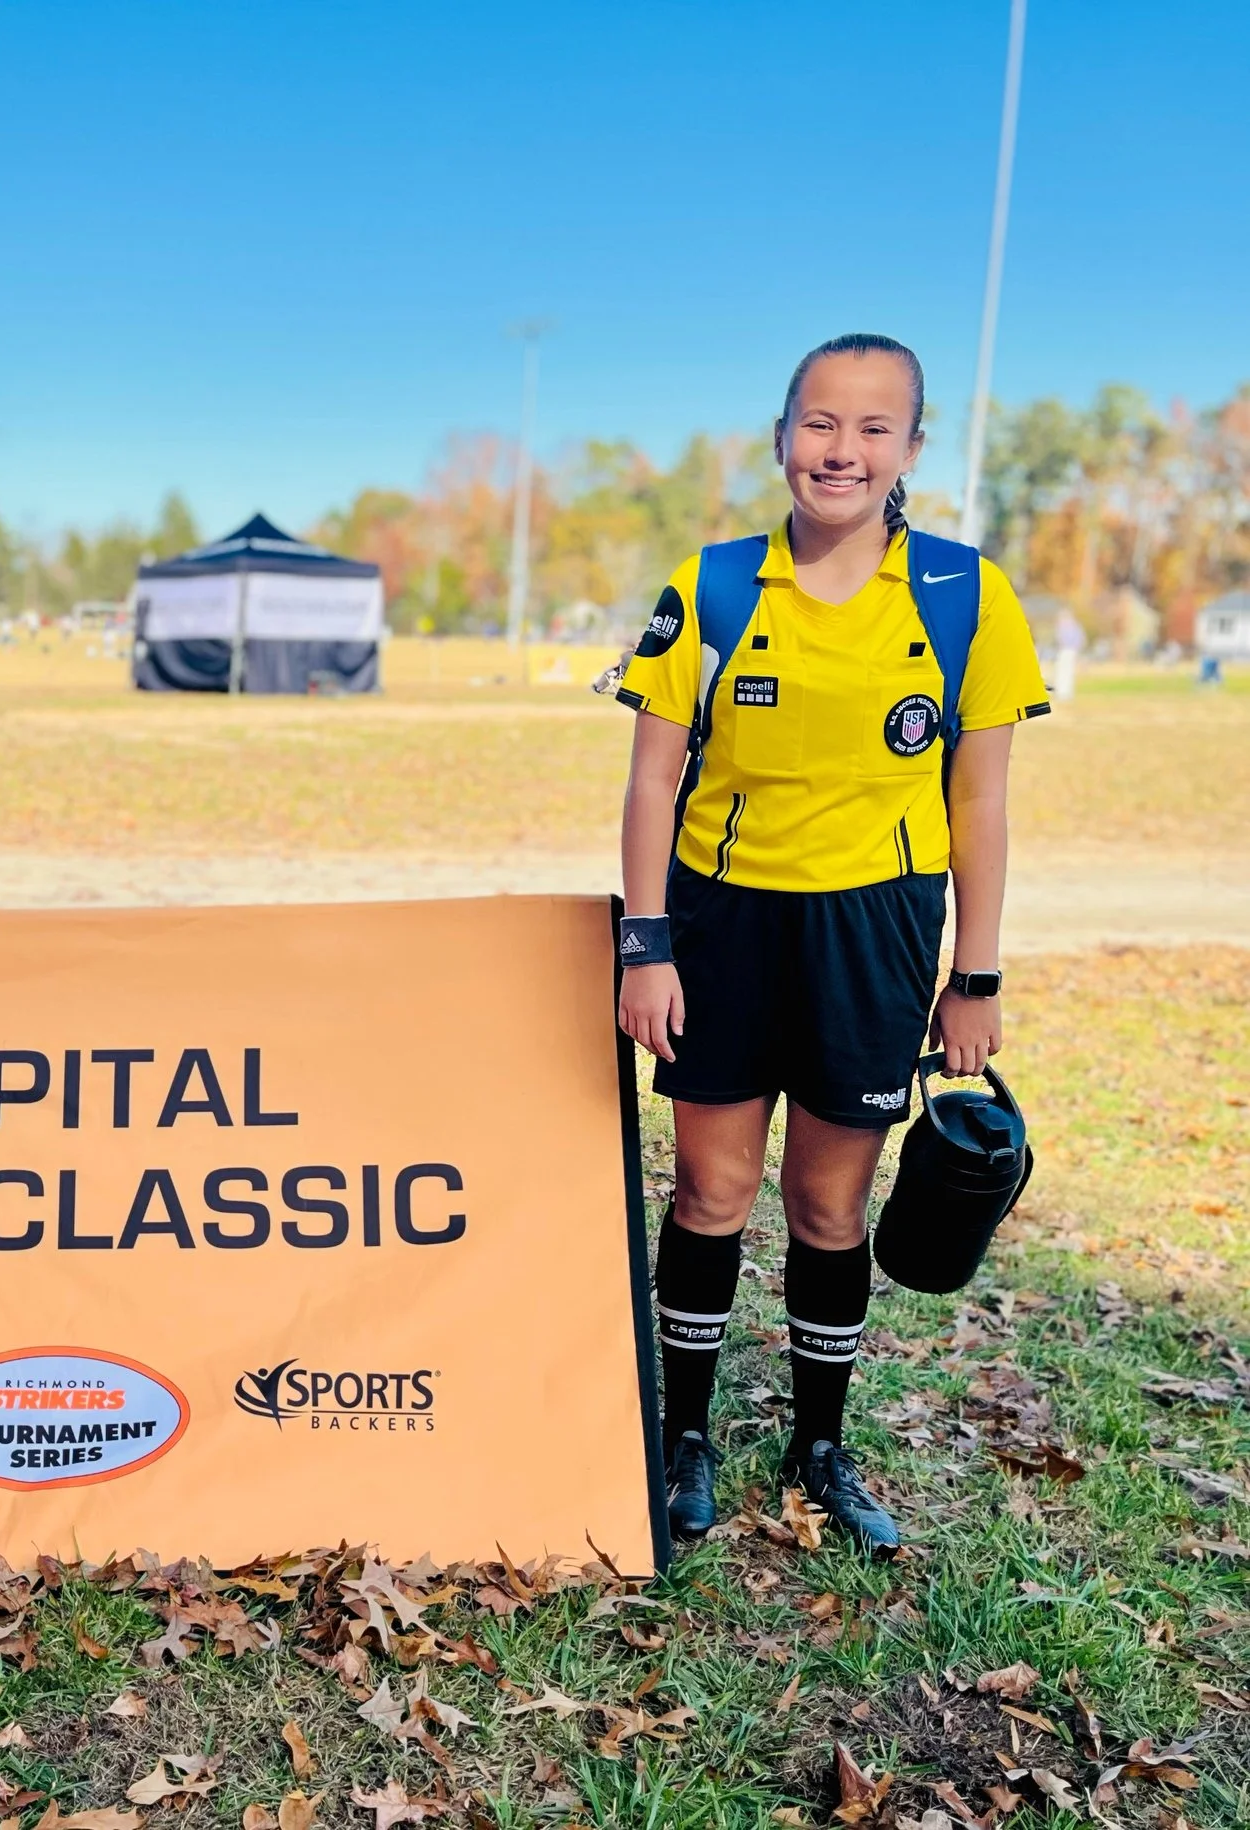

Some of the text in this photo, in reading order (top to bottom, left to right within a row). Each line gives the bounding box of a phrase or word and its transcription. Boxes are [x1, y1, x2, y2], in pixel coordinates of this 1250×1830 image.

[737, 681, 774, 693] capelli
[905, 711, 925, 725] USA
[620, 944, 646, 955] adidas
[861, 1087, 906, 1109] capelli
[5, 1379, 106, 1389] RICHMOND
[285, 1369, 434, 1411] SPORTS
[311, 1415, 435, 1432] BACKERS
[9, 1446, 103, 1469] SERIES
